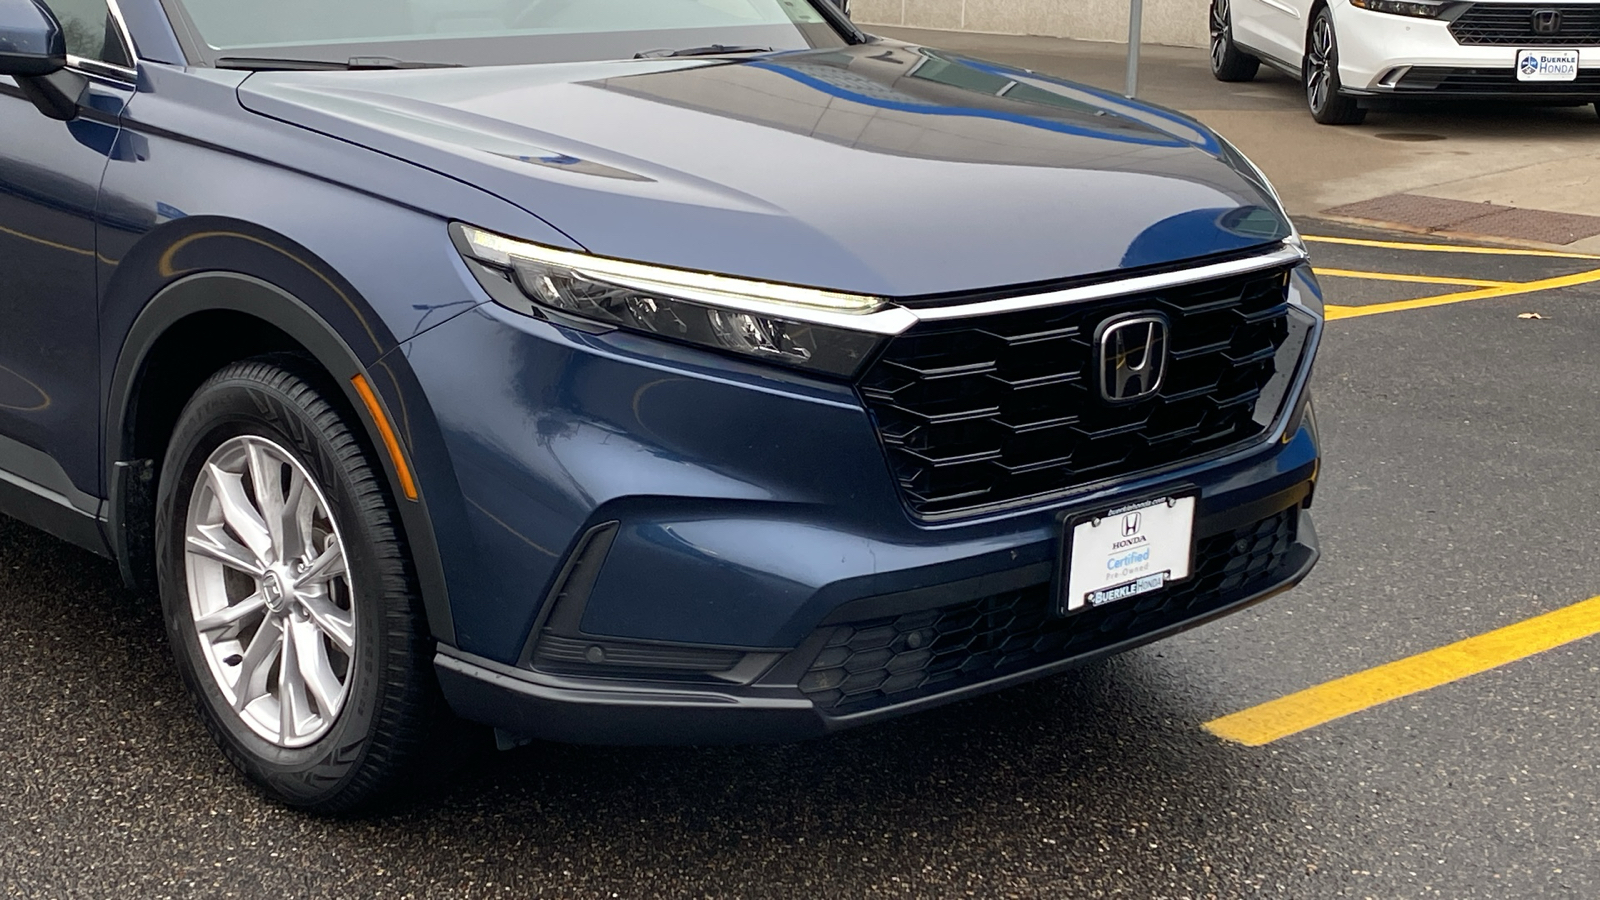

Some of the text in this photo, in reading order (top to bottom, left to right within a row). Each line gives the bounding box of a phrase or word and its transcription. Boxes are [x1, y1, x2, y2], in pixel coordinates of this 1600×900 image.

[1539, 63, 1574, 73] HONDA
[1112, 535, 1147, 550] HONDA
[1107, 548, 1150, 570] Certified
[1106, 563, 1149, 580] Pre-Owned
